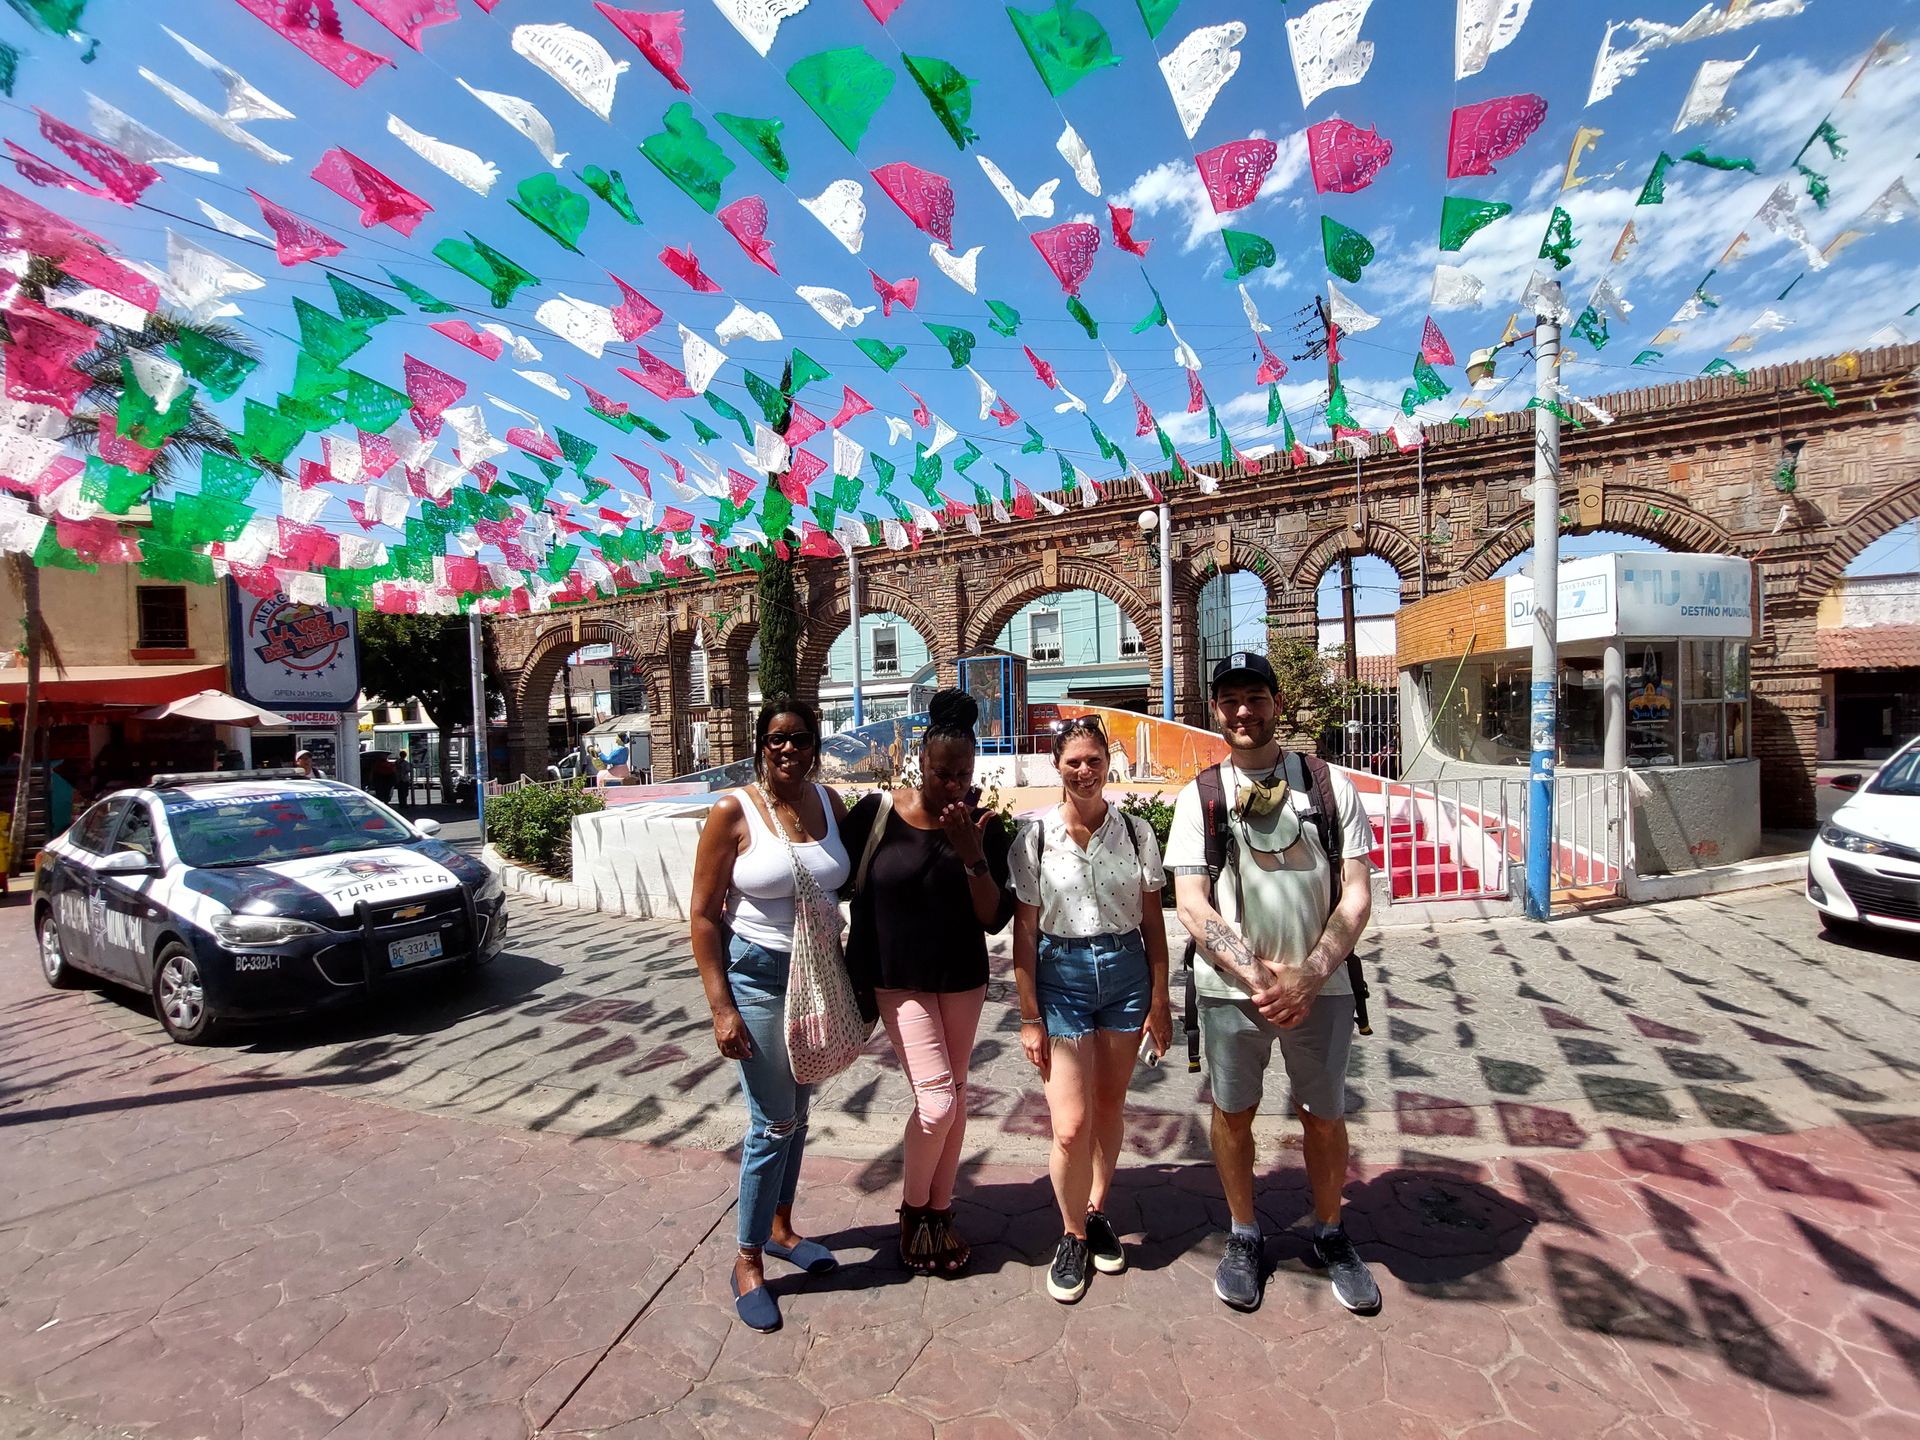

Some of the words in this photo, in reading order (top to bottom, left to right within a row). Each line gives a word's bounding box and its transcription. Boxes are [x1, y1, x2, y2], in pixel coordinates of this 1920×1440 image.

[1559, 578, 1603, 592] SSISTANCE
[1680, 606, 1721, 617] DESTINO
[267, 625, 294, 644] LA
[293, 614, 332, 635] VOZ
[262, 642, 294, 661] DEL
[293, 624, 348, 652] PUEBLO
[274, 689, 296, 697] OPEN
[307, 690, 333, 698] HOURS
[333, 874, 449, 901] TURISTICA
[391, 938, 440, 960] BC-332A-1
[235, 955, 281, 971] BC-332A-1
